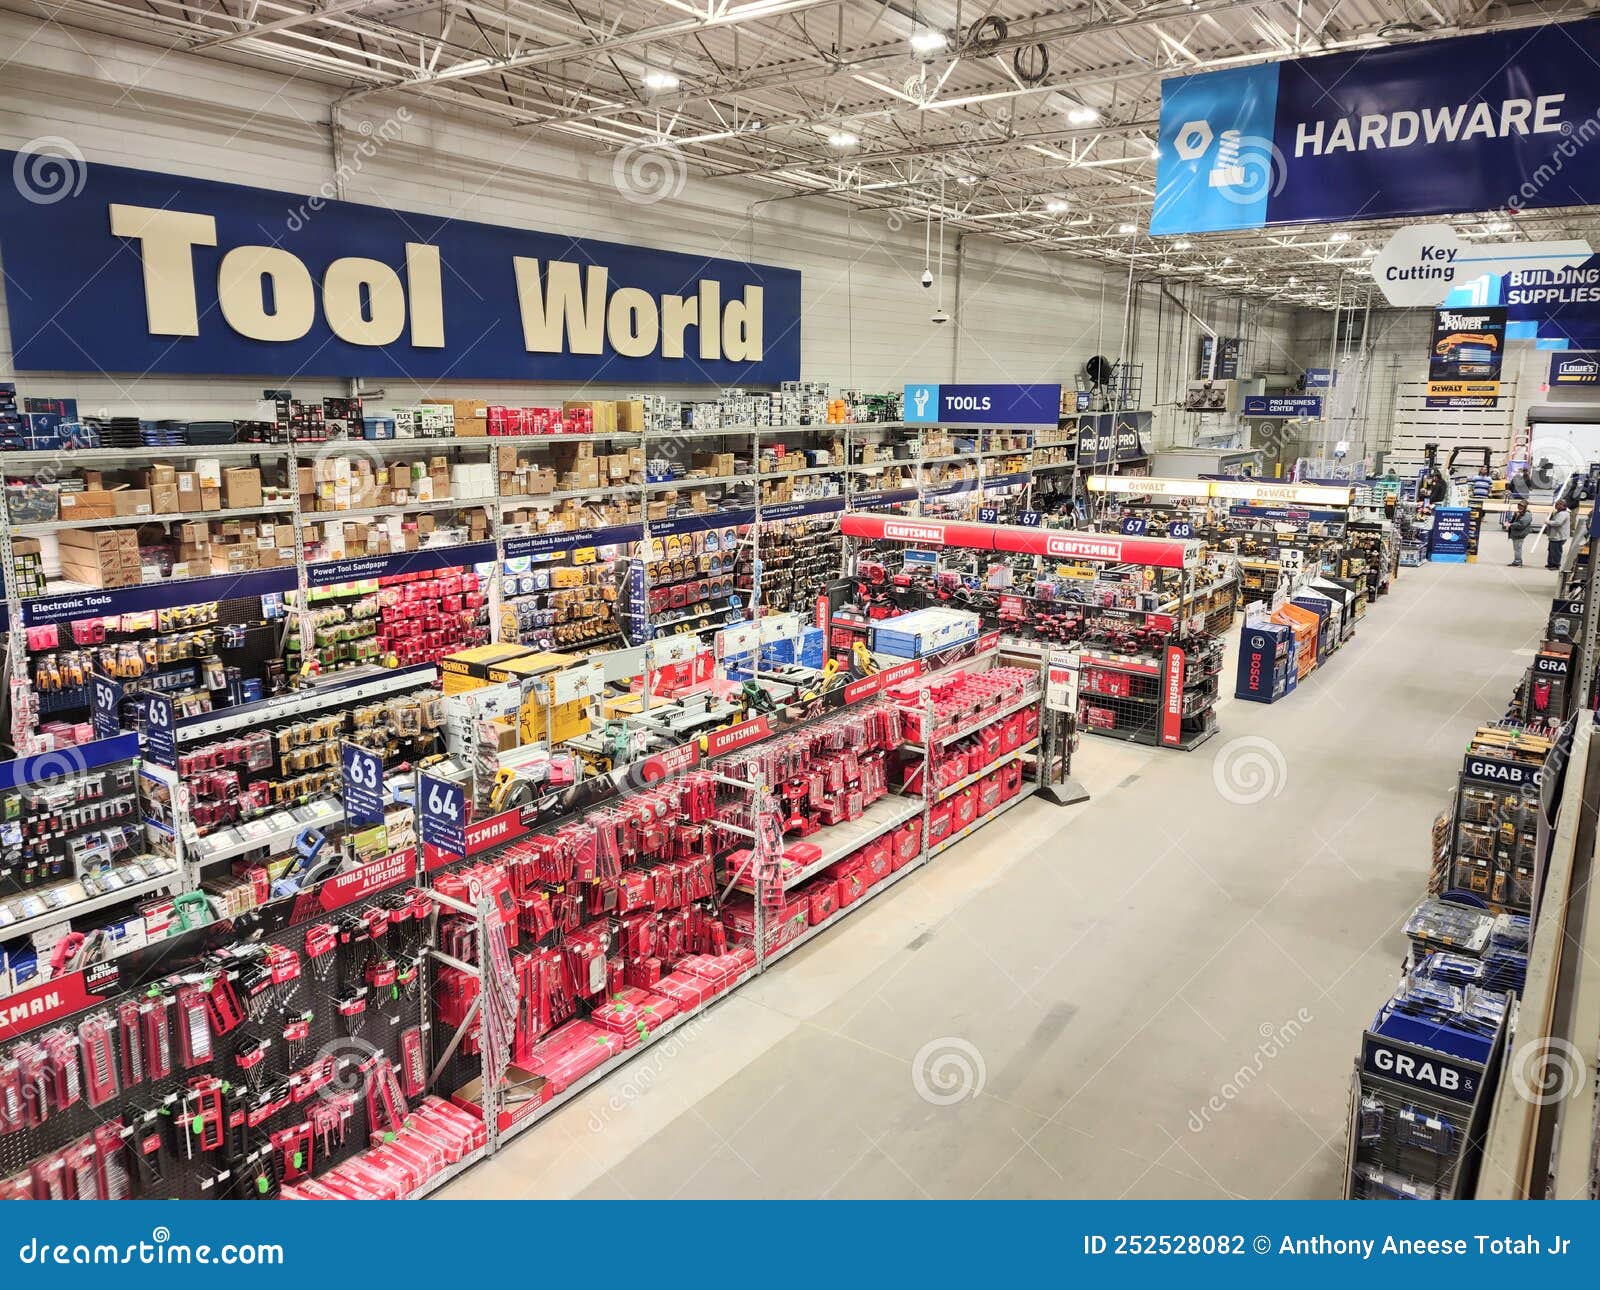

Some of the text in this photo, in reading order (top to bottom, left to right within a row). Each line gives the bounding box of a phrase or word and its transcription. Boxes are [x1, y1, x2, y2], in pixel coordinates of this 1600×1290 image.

[1294, 93, 1566, 158] HARDWARE
[1421, 246, 1458, 263] Key
[1386, 265, 1455, 282] Cutting
[1510, 268, 1600, 287] BUILDING
[108, 203, 764, 362] Tool World
[1507, 287, 1600, 305] SUPPLIES
[1440, 314, 1462, 323] NEXT
[1444, 320, 1482, 331] POWER
[945, 396, 991, 411] TOOLS
[1081, 438, 1097, 450] PRO
[1118, 433, 1135, 446] PRO
[981, 509, 995, 521] 59
[1023, 512, 1036, 525] 67
[887, 526, 940, 539] CRAFTSMAN
[1127, 521, 1142, 532] 67
[1173, 524, 1190, 536] 68
[507, 541, 530, 550] Diamond
[554, 536, 574, 544] Abrasive
[575, 533, 593, 541] Wheels
[1051, 541, 1117, 556] CRAFTSMAN
[313, 561, 389, 576] Power Tool Sandpaper
[1280, 560, 1298, 568] LEX
[32, 596, 112, 613] Electronic Tools
[1249, 653, 1262, 690] BOSCH
[1539, 659, 1567, 673] GRA
[1169, 653, 1181, 714] BRUSHLESS
[96, 683, 113, 711] 59
[149, 700, 168, 727] 63
[716, 724, 759, 747] CRAFTSMAN
[351, 754, 377, 788] 63
[1471, 762, 1522, 782] GRAB
[1533, 772, 1543, 785] G
[428, 784, 458, 821] 64
[467, 821, 507, 846] TSMAN
[336, 871, 363, 888] TOOLS
[364, 862, 385, 877] THAT
[386, 854, 406, 869] LAST
[363, 878, 369, 888] A
[371, 863, 406, 886] LIFETIME
[86, 965, 119, 983] LIFETIME
[93, 962, 110, 974] FULL
[0, 992, 60, 1029] SMAN
[1374, 1049, 1459, 1091] GRAB
